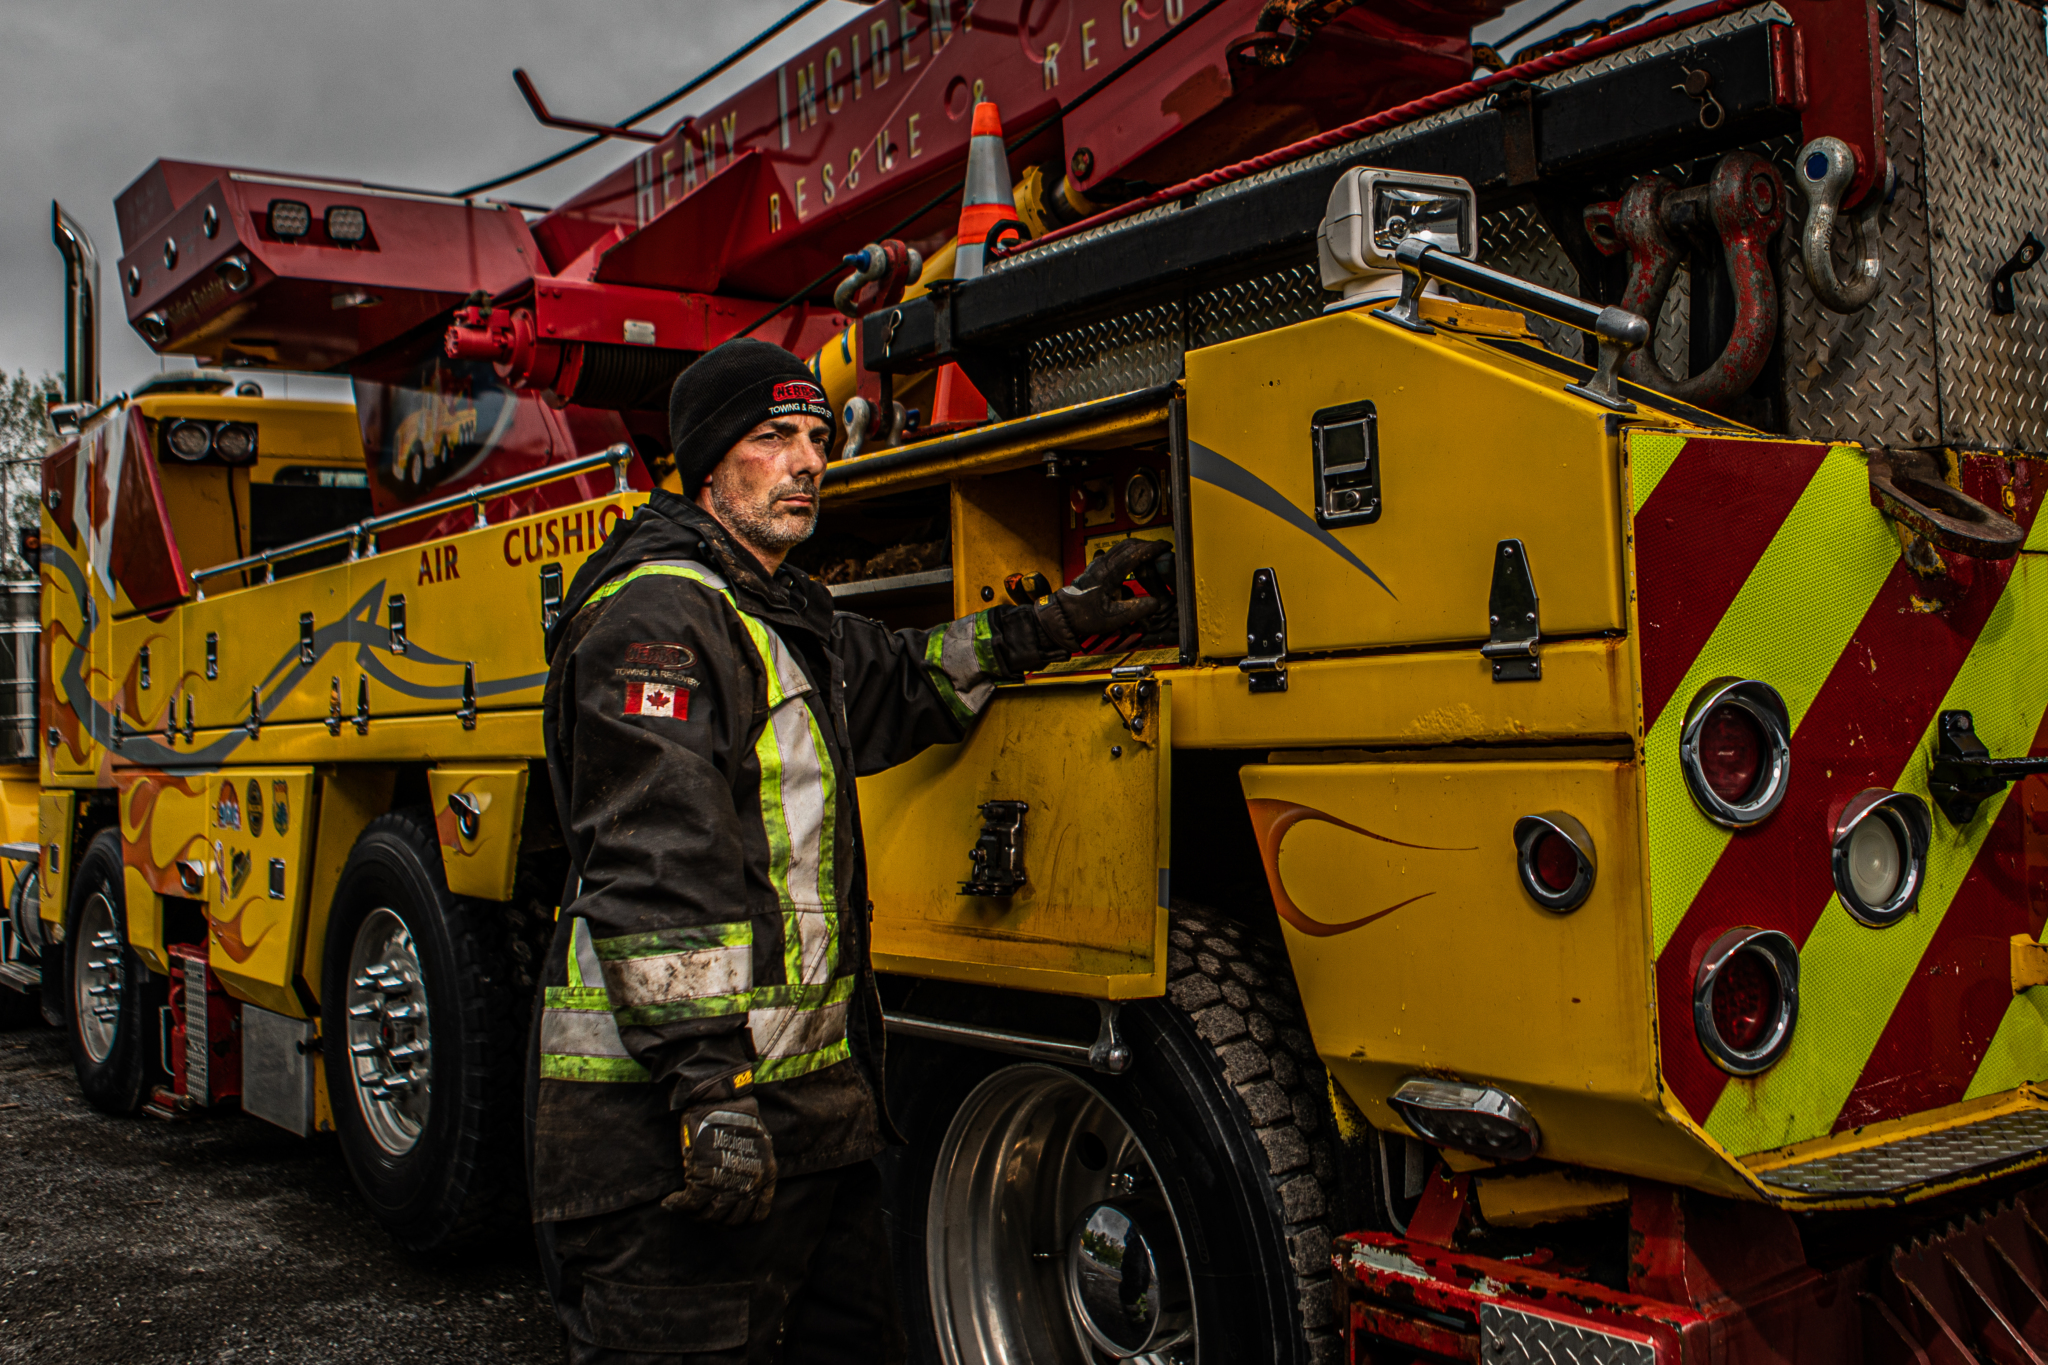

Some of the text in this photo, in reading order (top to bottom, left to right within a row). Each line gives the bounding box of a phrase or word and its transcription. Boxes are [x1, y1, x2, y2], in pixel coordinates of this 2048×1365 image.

[634, 110, 737, 230] HEAVY
[768, 113, 922, 234] RESCUE
[768, 403, 800, 415] TOWING
[801, 403, 808, 412] &
[417, 503, 641, 587] AIR CUSHIO
[614, 668, 700, 687] TOWING & RECOVERY
